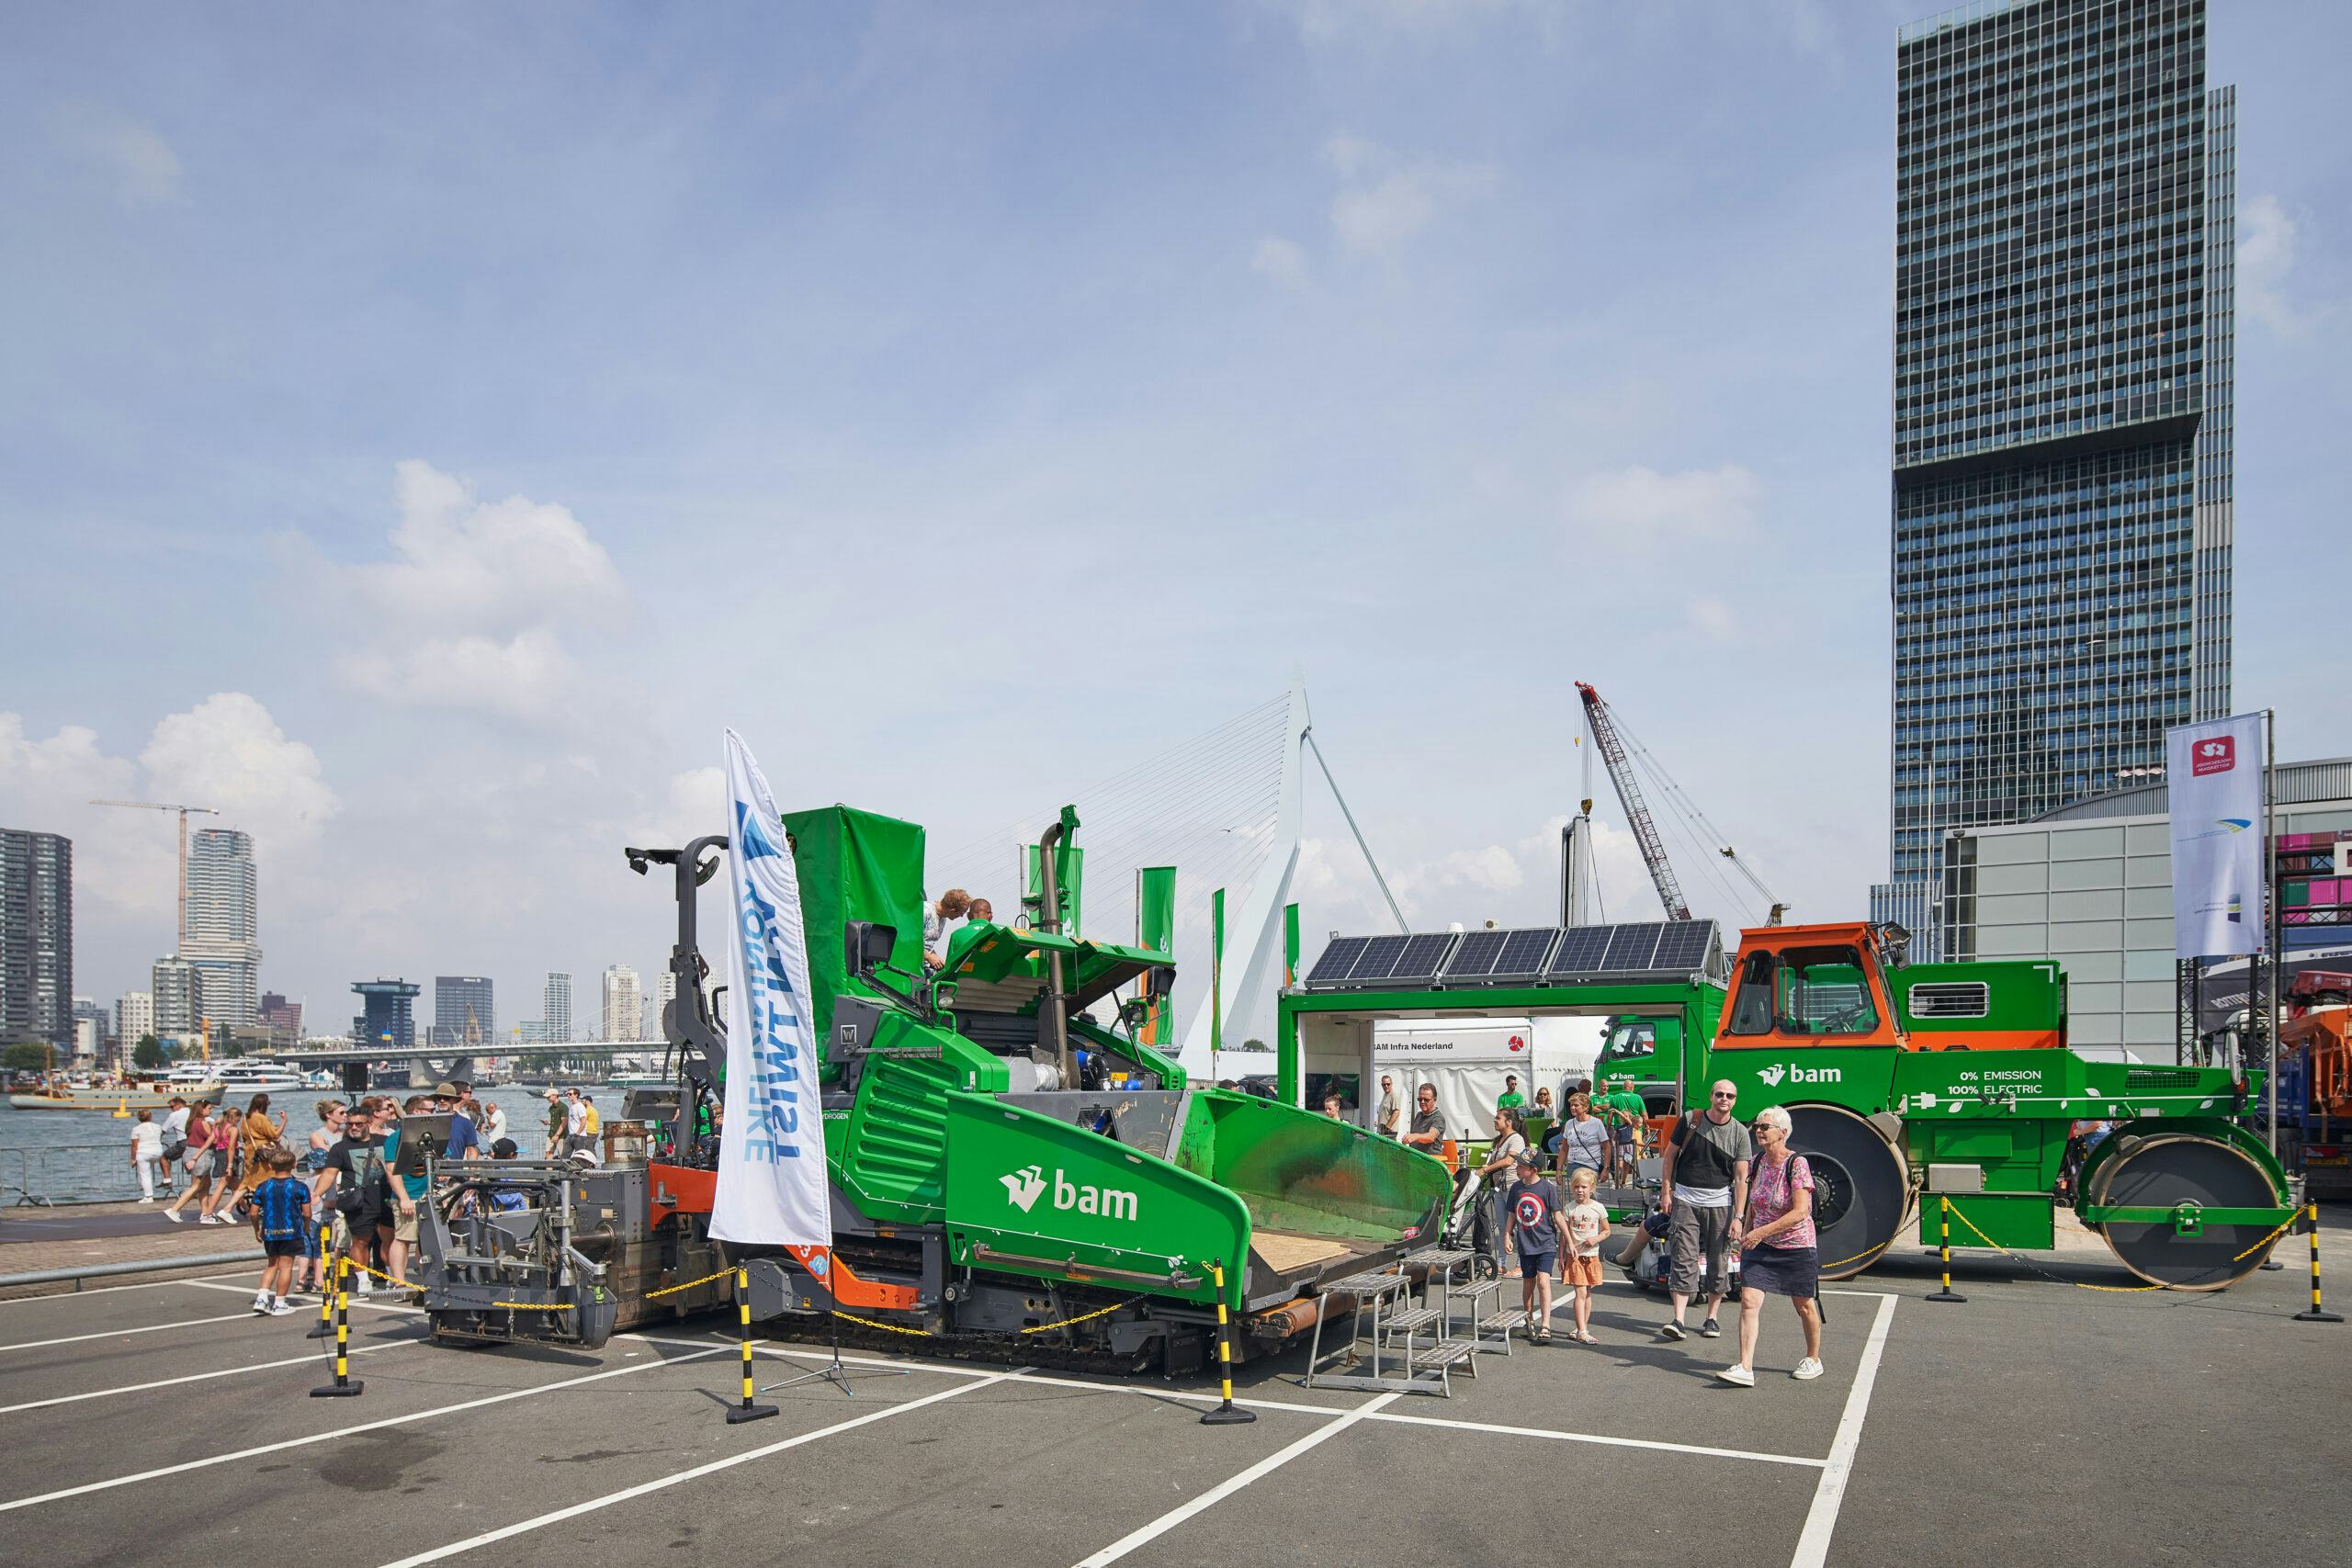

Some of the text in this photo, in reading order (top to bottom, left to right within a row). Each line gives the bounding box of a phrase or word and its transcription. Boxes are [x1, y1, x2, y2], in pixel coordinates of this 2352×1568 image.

[1618, 1072, 1635, 1080] bam
[1790, 1063, 1842, 1083] bam
[1960, 1070, 2041, 1081] 0% EMISSION
[1948, 1085, 2042, 1095] 100% ELECTRIC
[1054, 1168, 1138, 1222] bam
